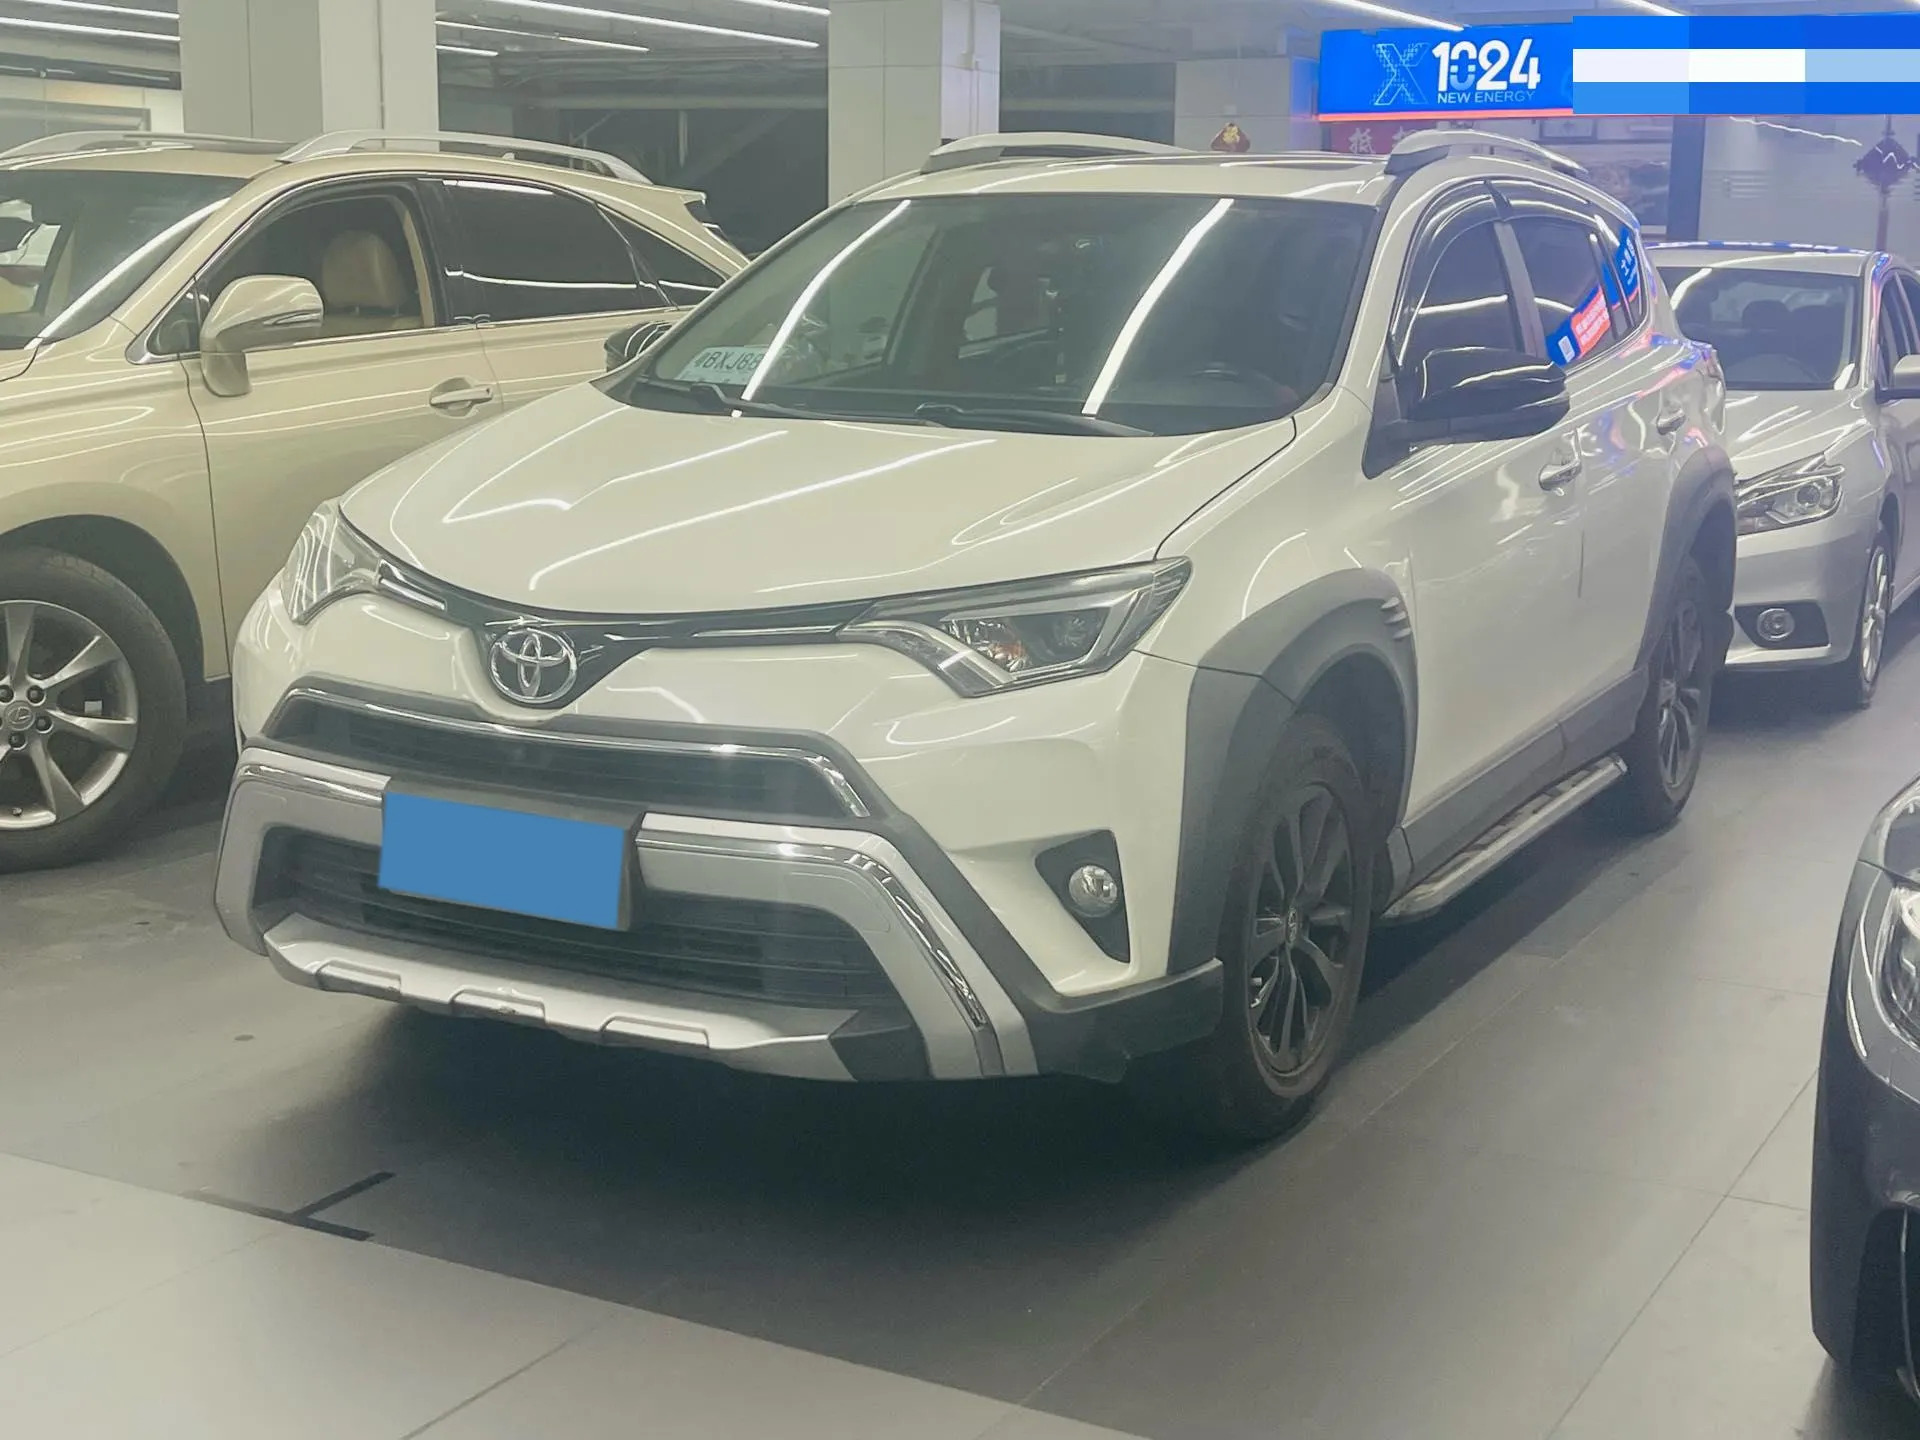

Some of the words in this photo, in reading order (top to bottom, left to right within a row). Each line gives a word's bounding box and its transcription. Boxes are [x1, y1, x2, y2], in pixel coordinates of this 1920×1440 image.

[1432, 38, 1541, 92] 1024
[1437, 92, 1471, 104] NEW
[1474, 90, 1536, 104] ENERGY
